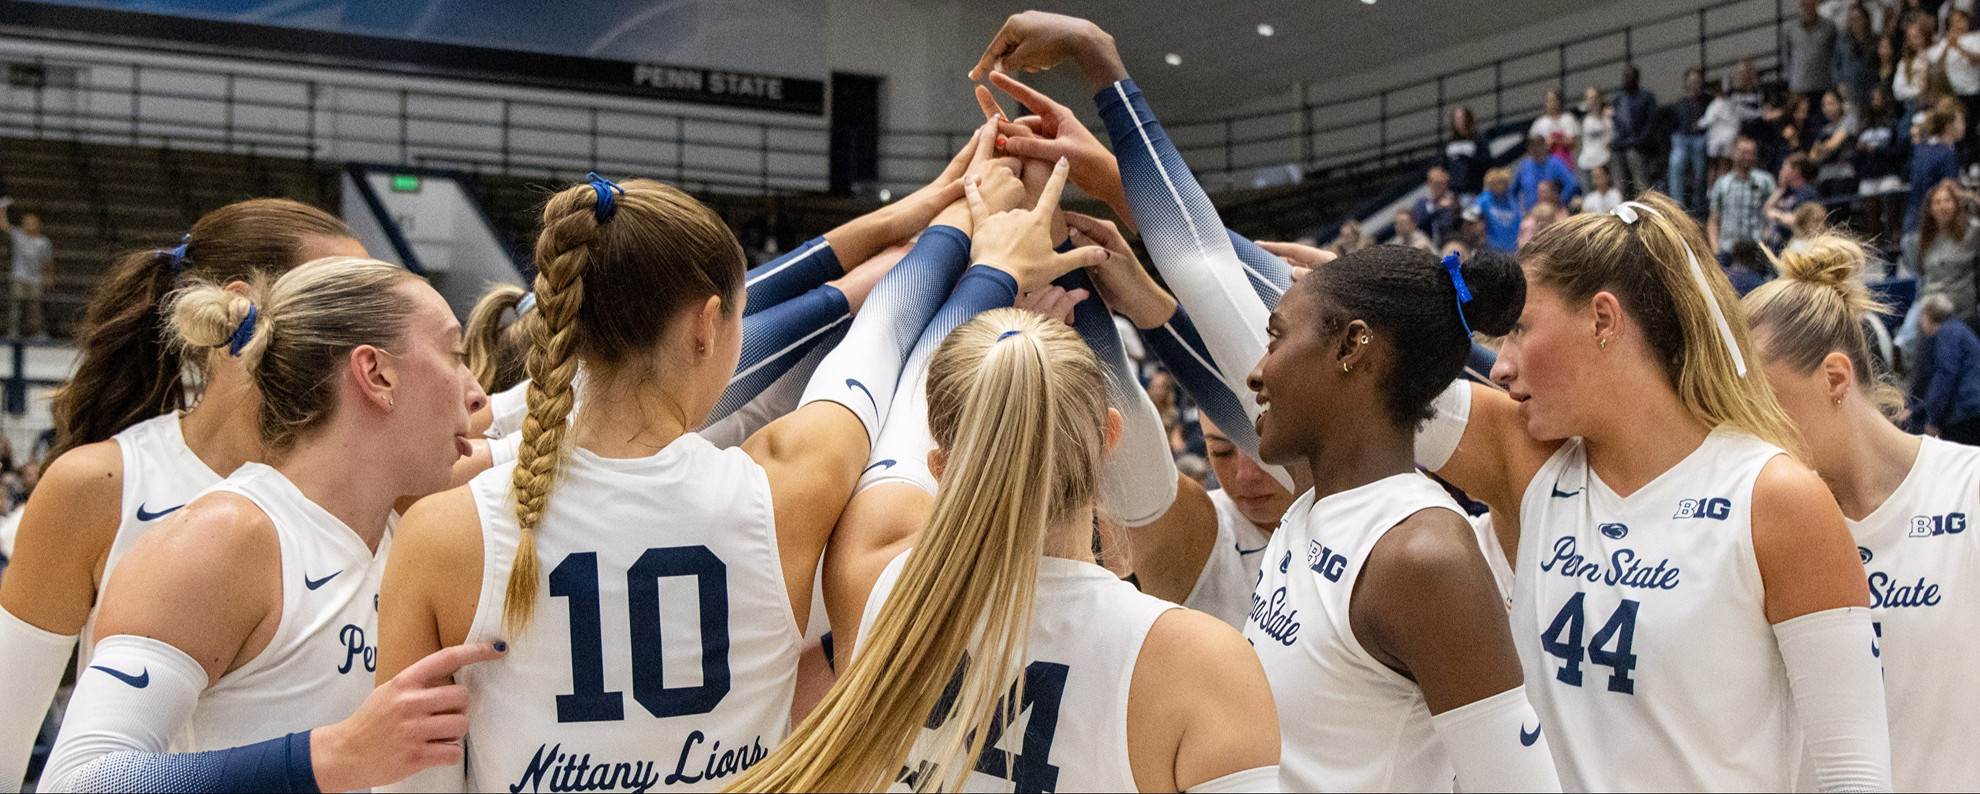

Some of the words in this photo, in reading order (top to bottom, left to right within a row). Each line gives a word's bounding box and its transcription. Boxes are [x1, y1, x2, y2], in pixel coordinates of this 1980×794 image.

[634, 65, 702, 91] PENN
[707, 72, 782, 99] STATE
[1604, 548, 1680, 590] State
[1868, 571, 1941, 609] State
[549, 544, 731, 723] 10
[1260, 586, 1301, 646] State
[1540, 591, 1640, 695] 44
[510, 743, 659, 793] Nittany
[665, 730, 769, 785] Lions
